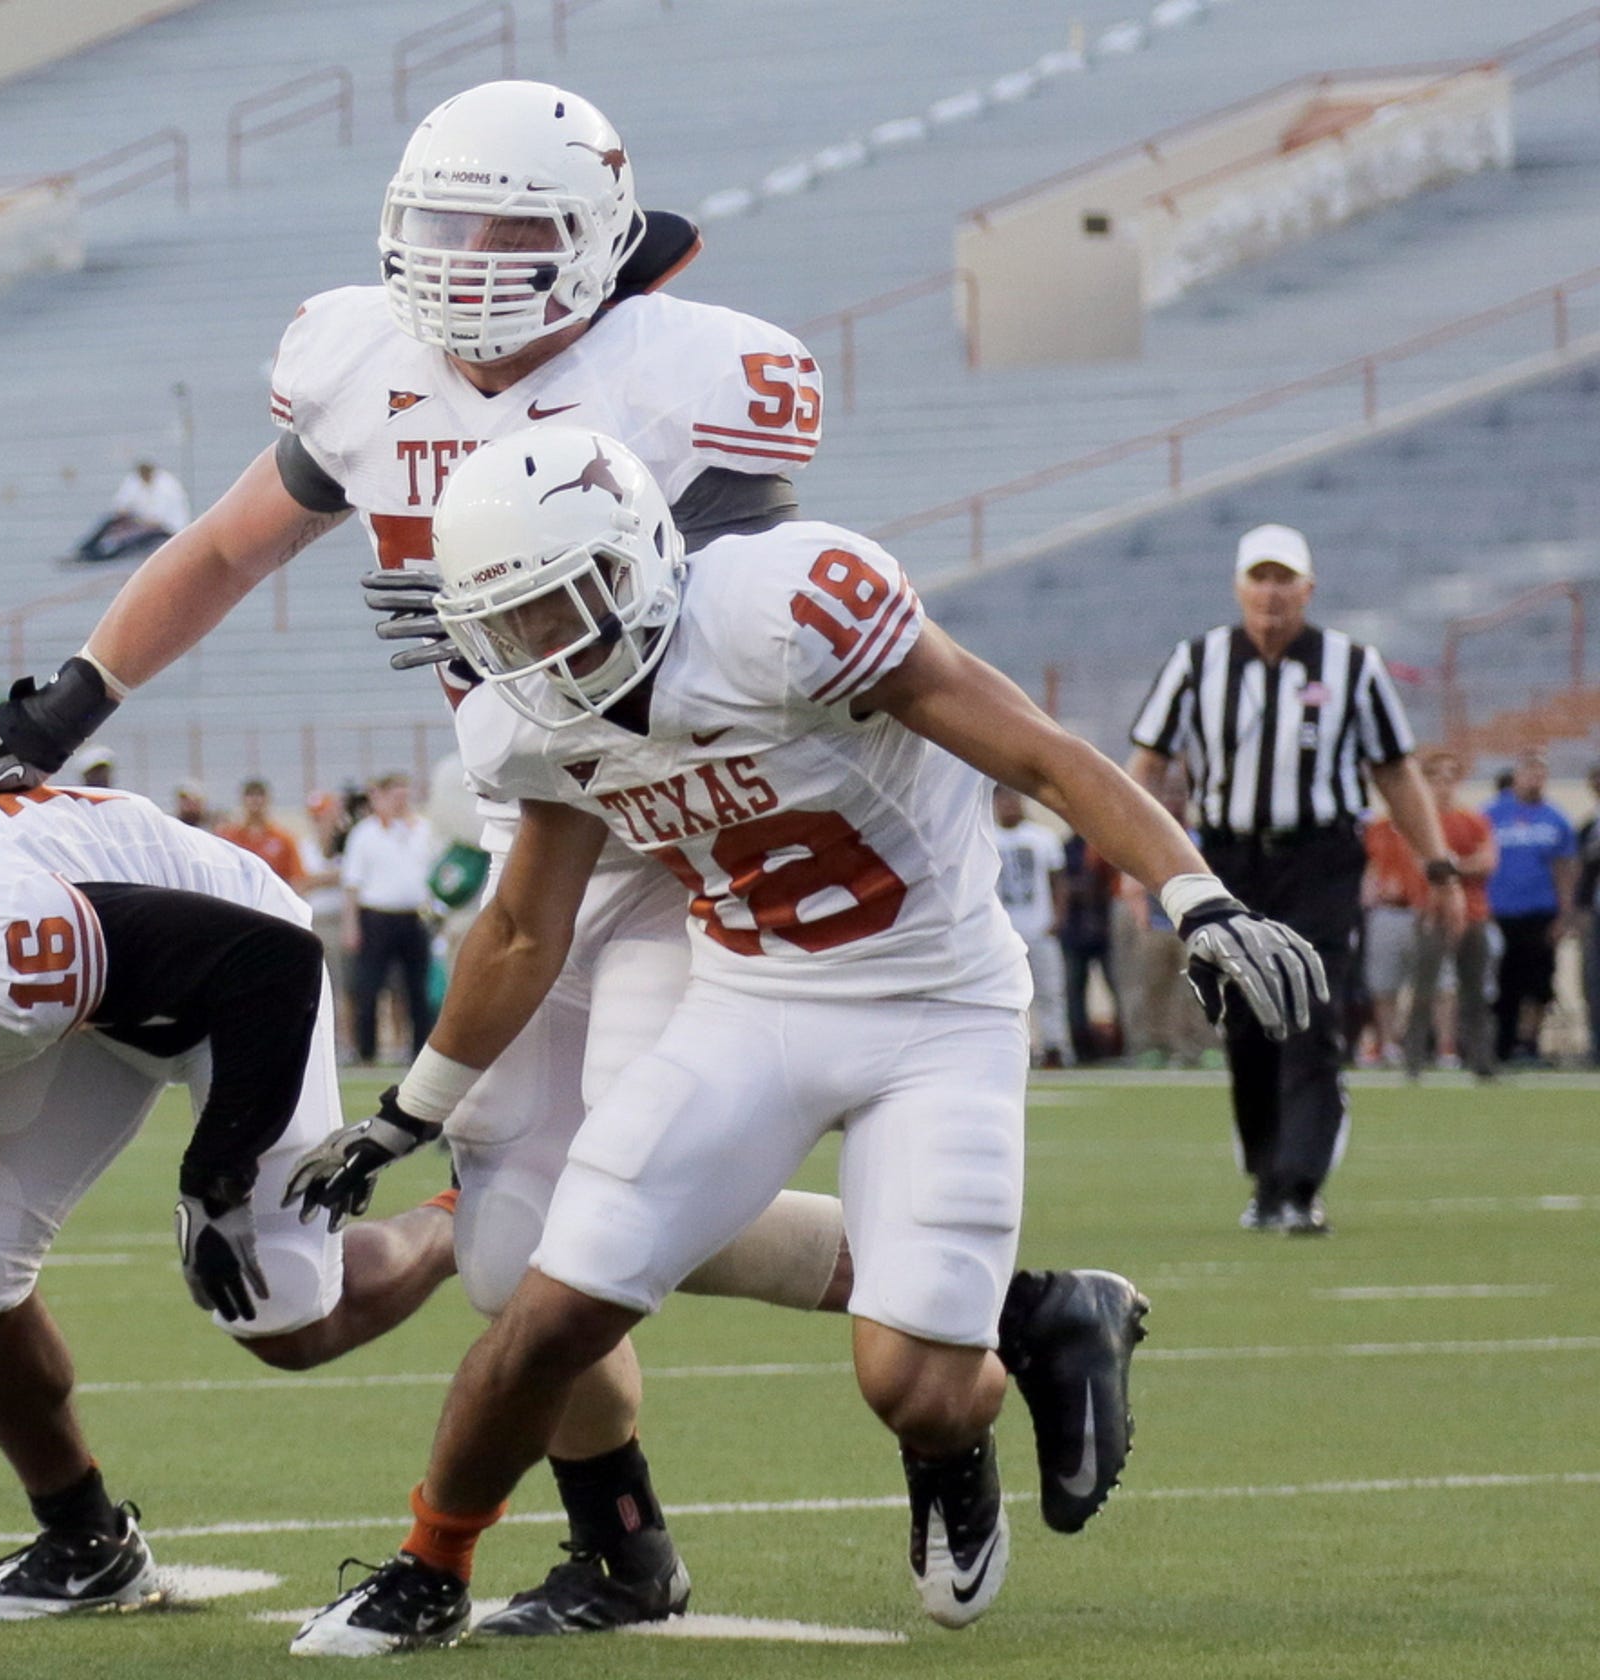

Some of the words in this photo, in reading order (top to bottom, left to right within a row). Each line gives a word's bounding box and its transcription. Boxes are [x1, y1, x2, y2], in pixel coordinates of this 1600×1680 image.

[451, 171, 491, 184] HORNS
[471, 562, 508, 585] HORNS
[789, 547, 890, 660] 18
[596, 755, 779, 844] TEXAS
[648, 810, 909, 957] 18
[4, 915, 78, 1010] 16
